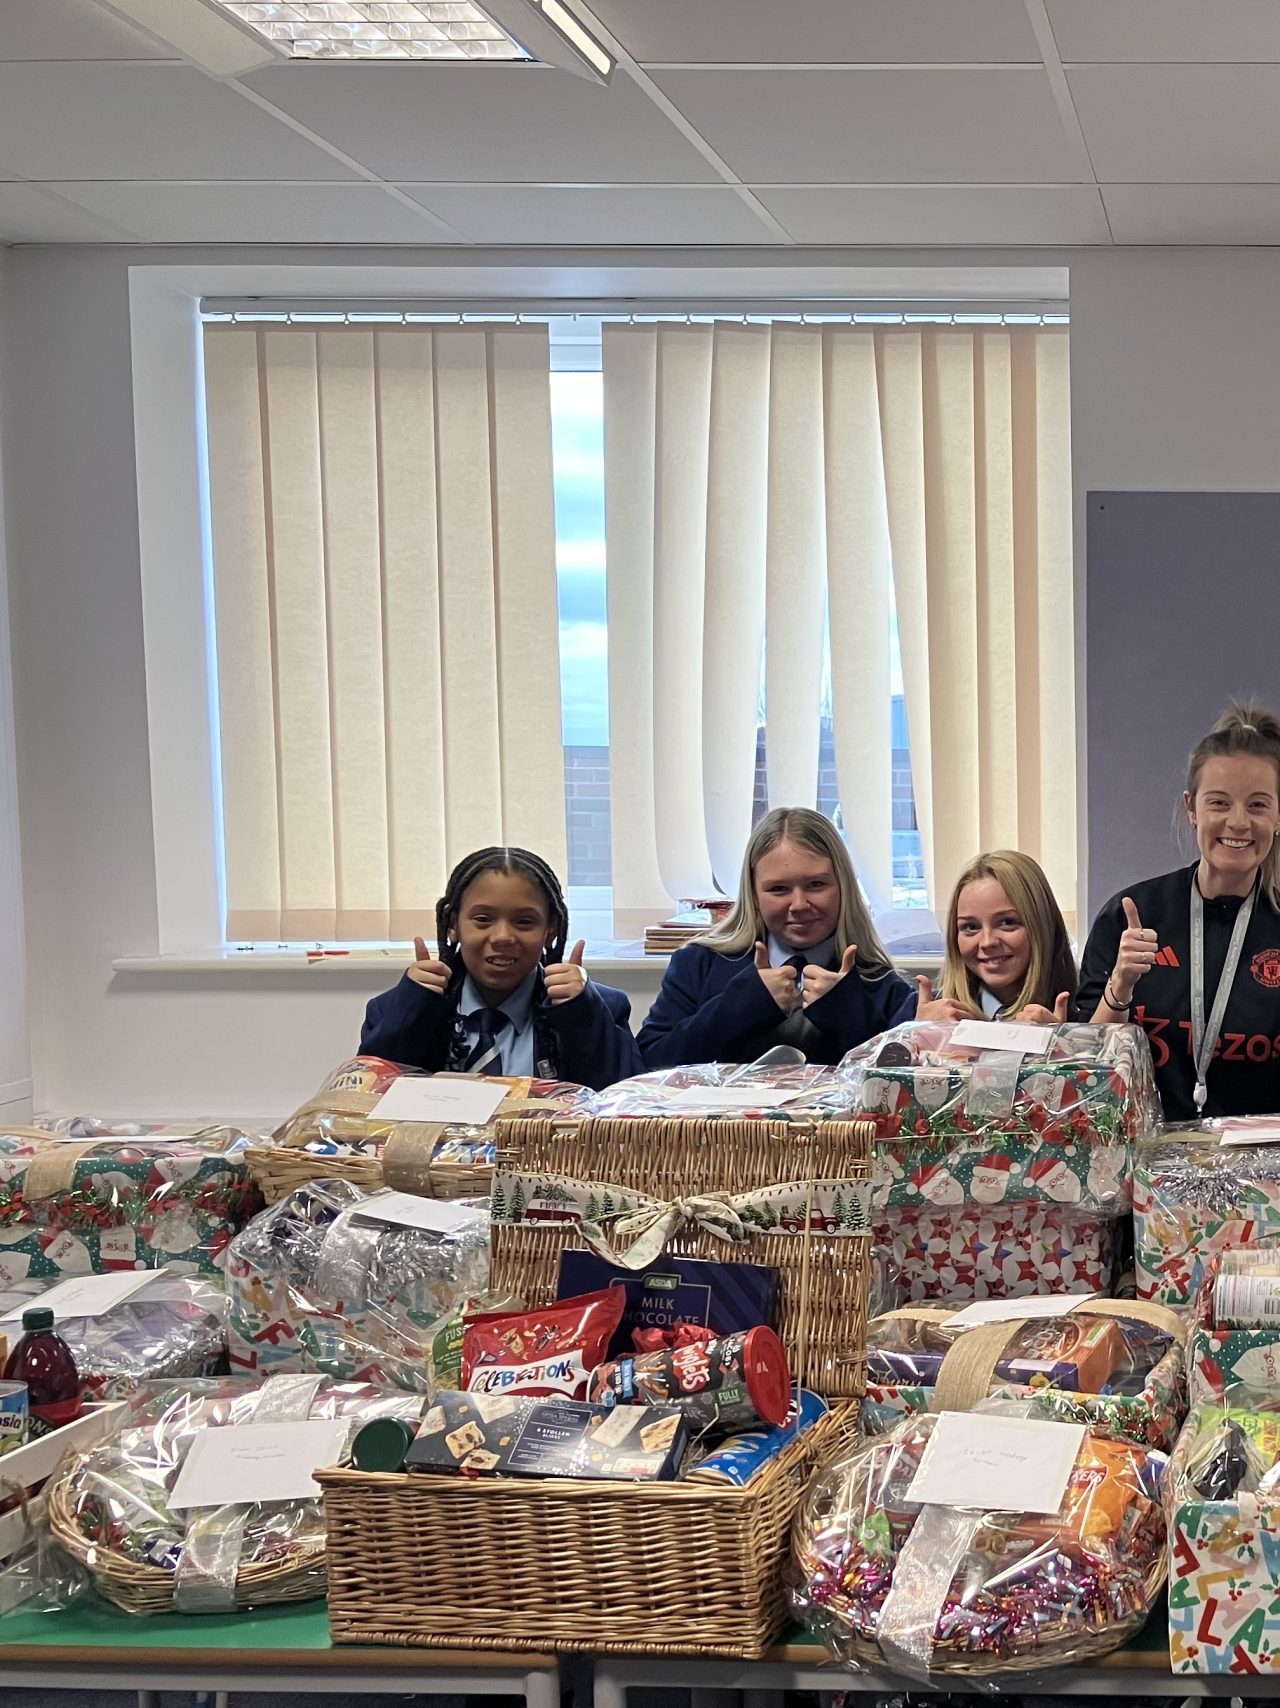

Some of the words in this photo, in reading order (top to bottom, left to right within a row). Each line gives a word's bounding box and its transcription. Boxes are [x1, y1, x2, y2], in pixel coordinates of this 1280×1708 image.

[648, 1278, 673, 1288] ASDA
[641, 1297, 675, 1310] MILK
[624, 1311, 700, 1326] HOCOLATE
[445, 1326, 463, 1343] FUS
[718, 1389, 739, 1401] FULLY
[1070, 1468, 1106, 1484] KERS
